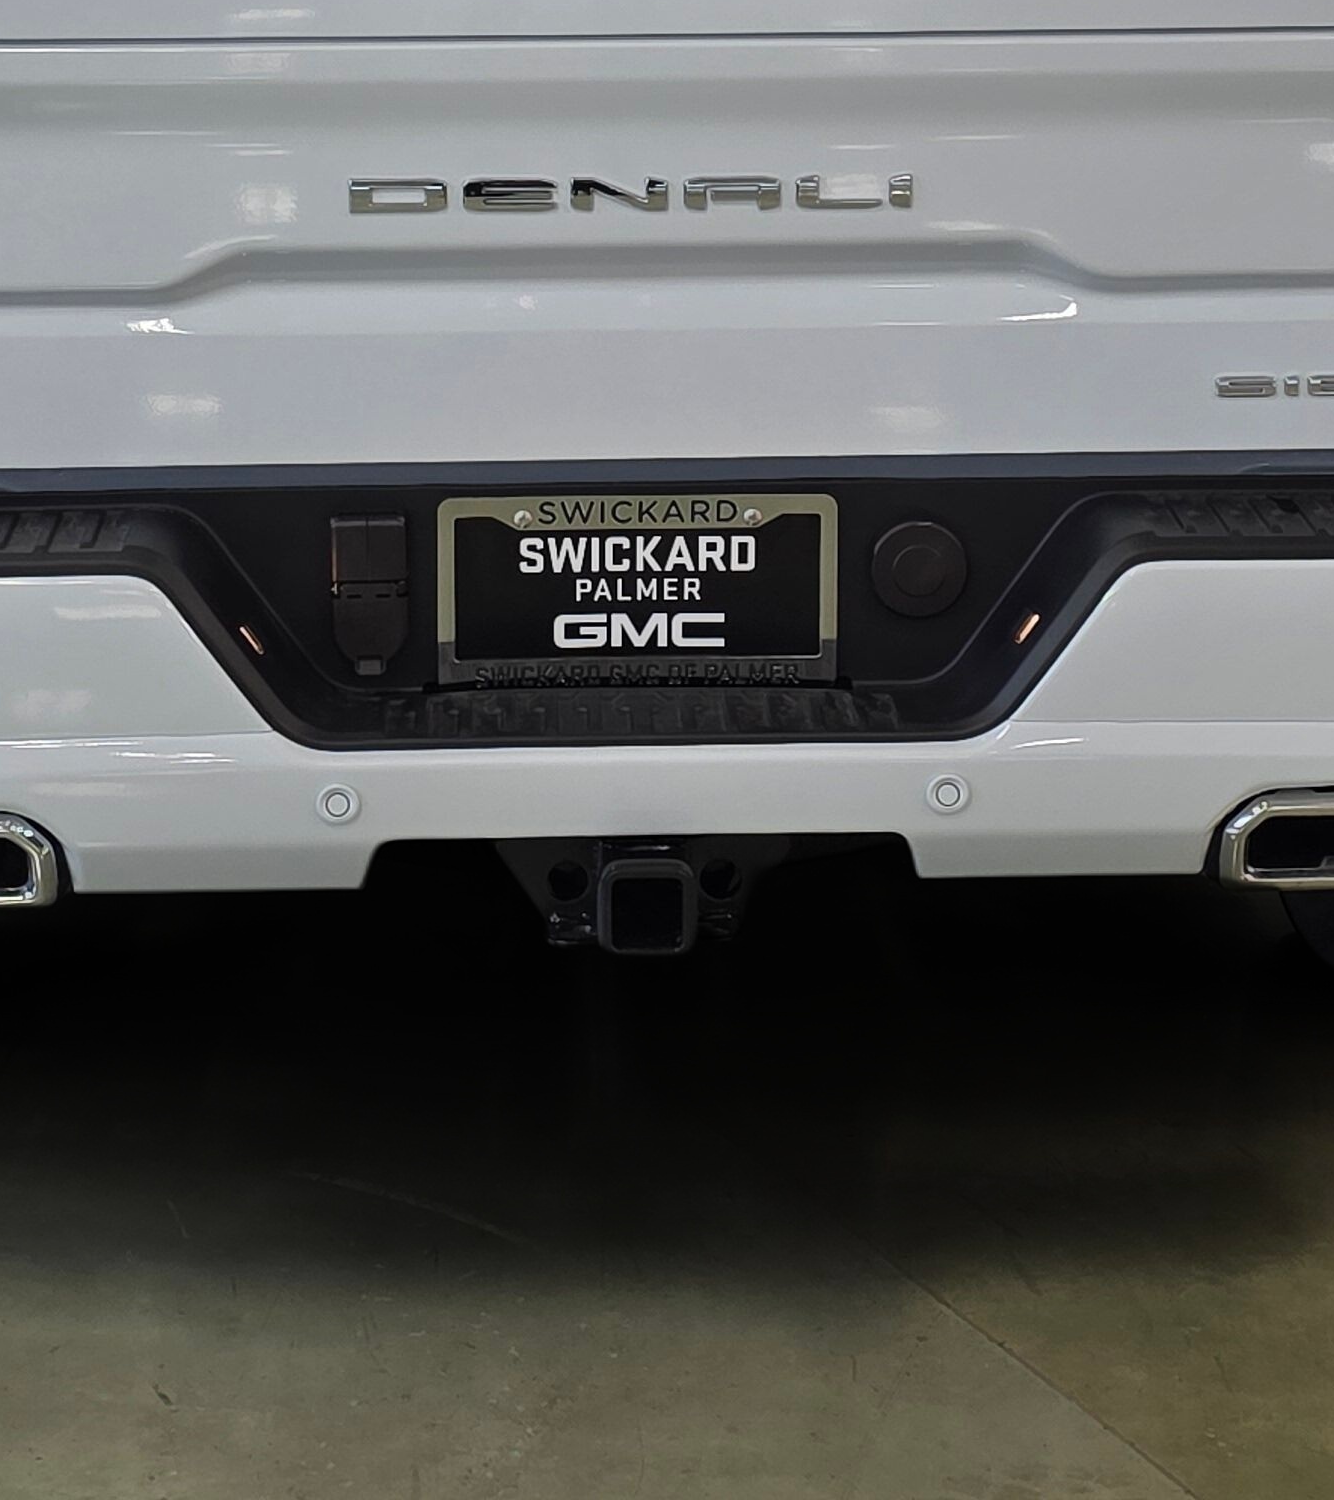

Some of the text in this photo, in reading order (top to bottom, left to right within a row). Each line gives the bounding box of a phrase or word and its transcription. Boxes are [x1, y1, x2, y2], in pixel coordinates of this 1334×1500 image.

[348, 174, 912, 214] DENALI
[537, 499, 738, 526] SWICKARD
[518, 535, 757, 575] SWICKARD
[575, 577, 702, 603] PALMER
[553, 612, 726, 650] GMC
[475, 664, 601, 689] SWICKARD
[704, 662, 800, 686] PALMER
